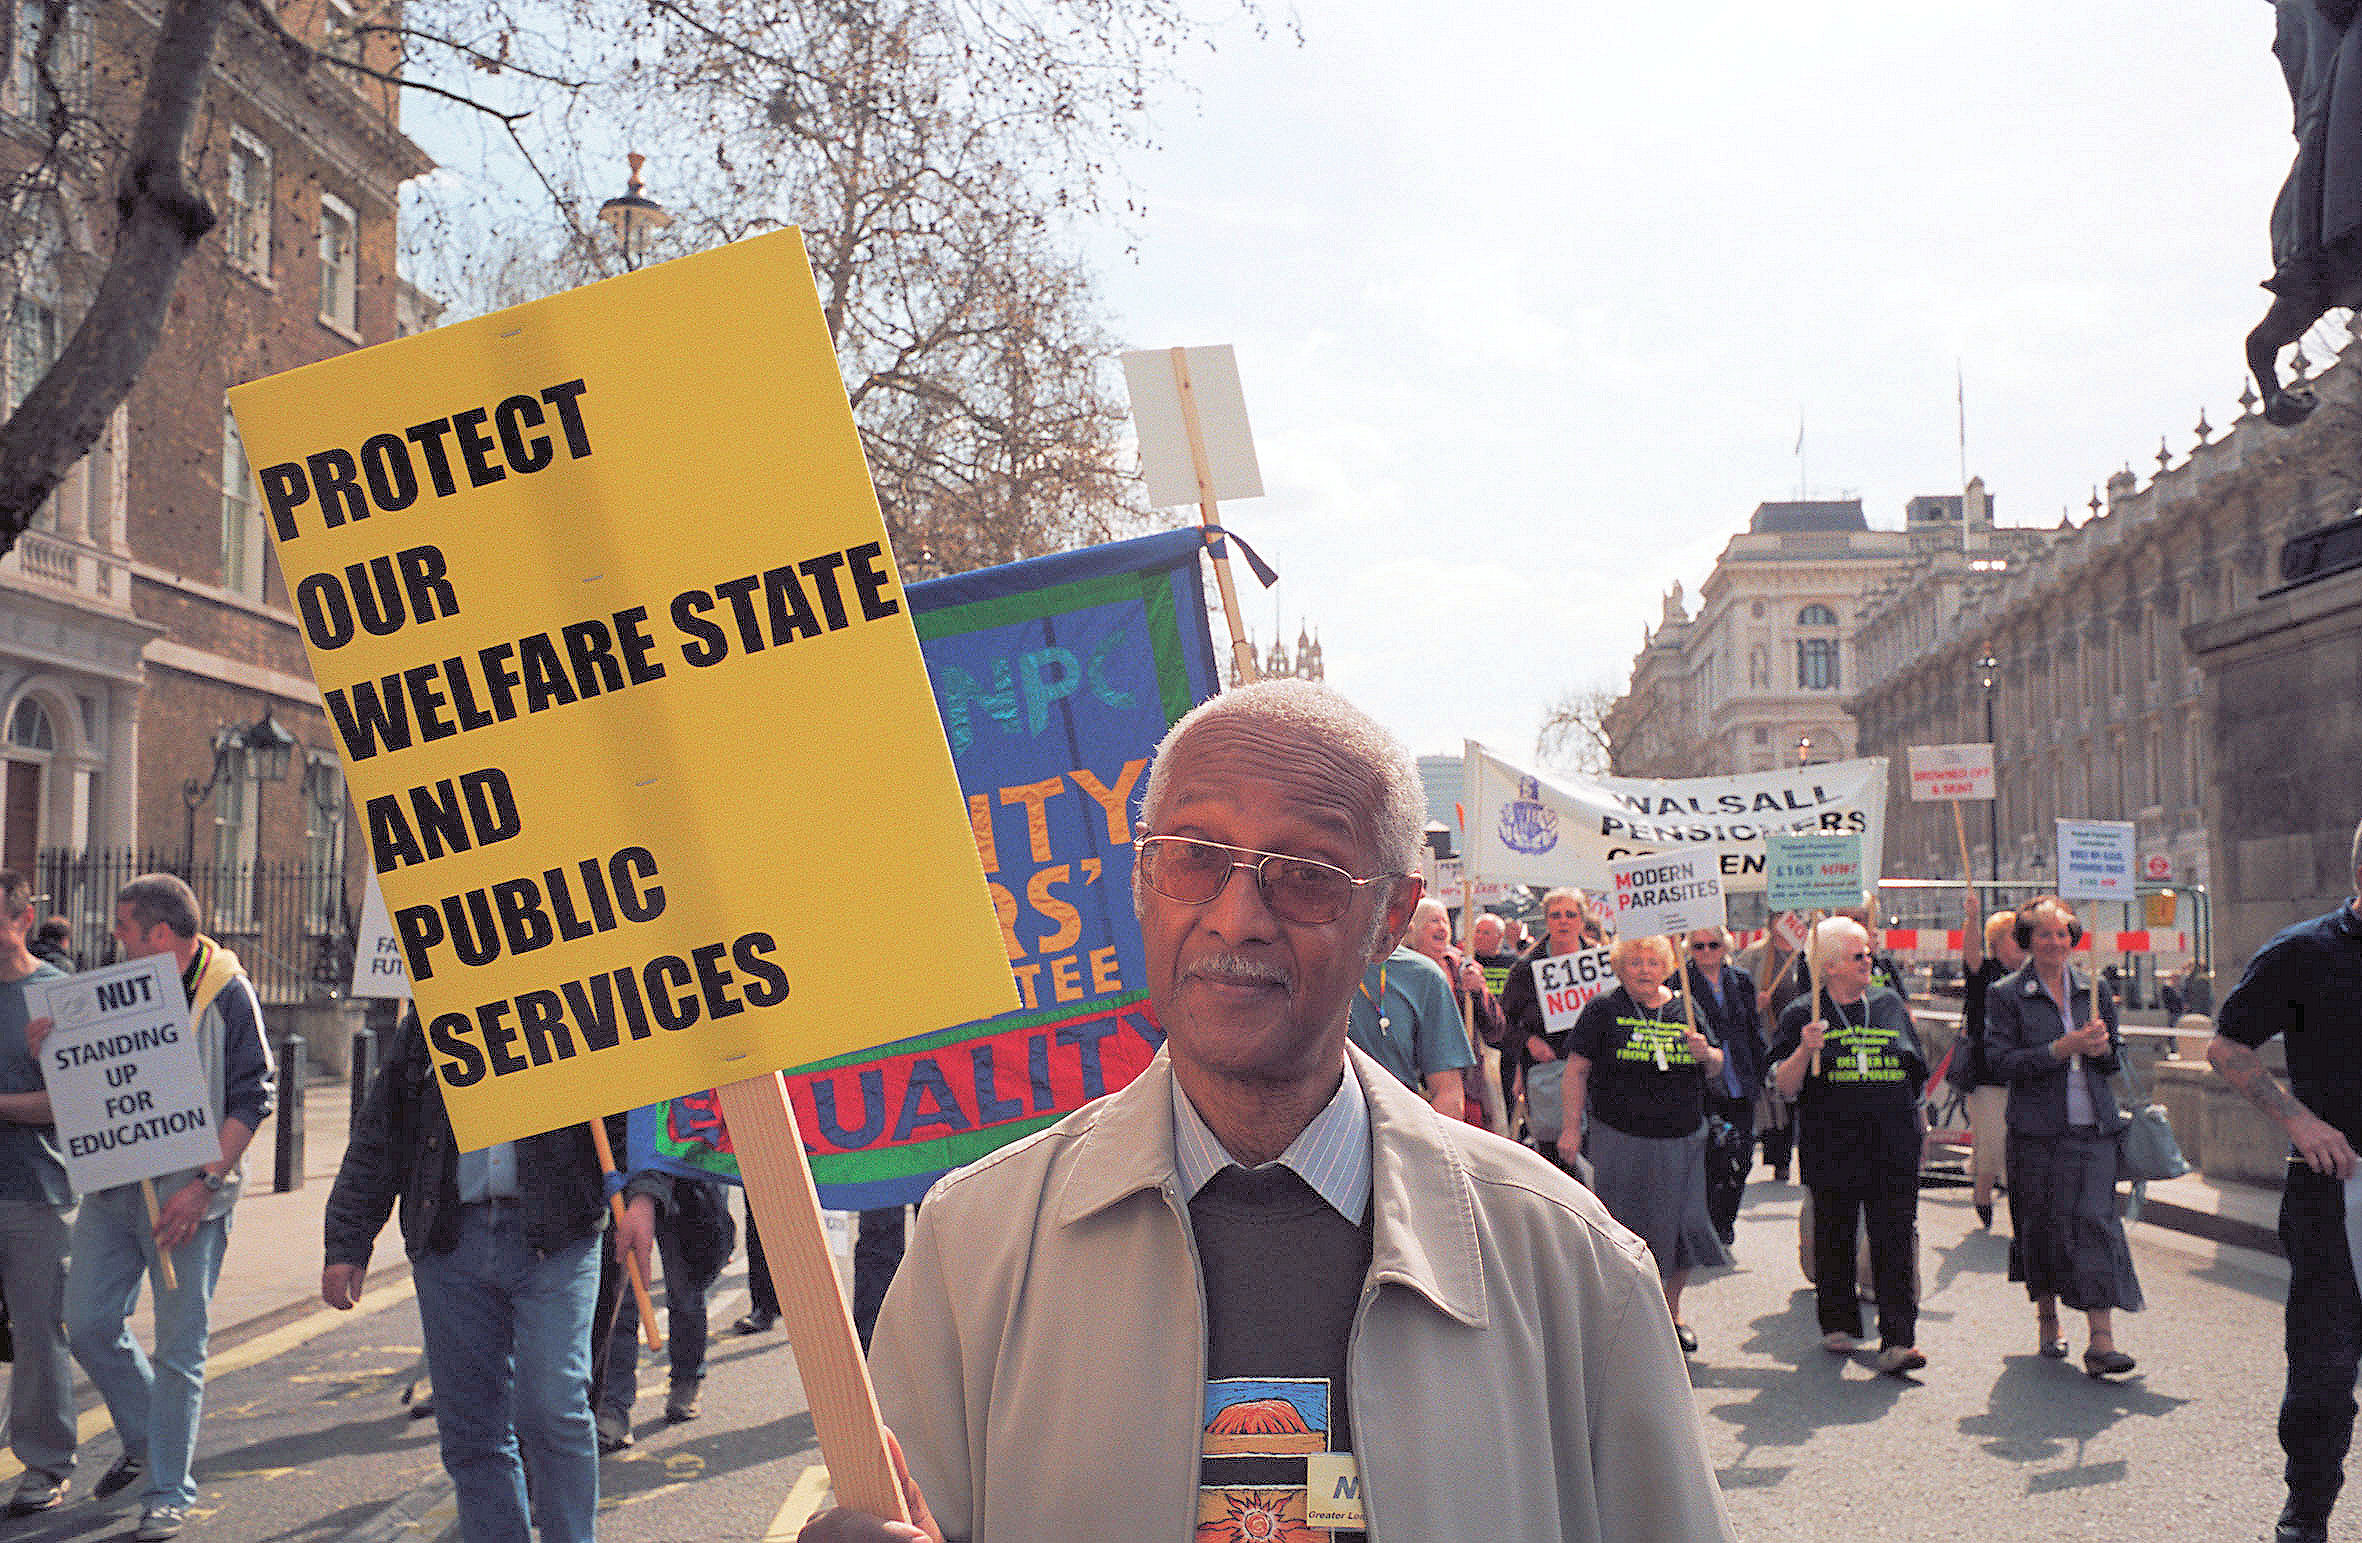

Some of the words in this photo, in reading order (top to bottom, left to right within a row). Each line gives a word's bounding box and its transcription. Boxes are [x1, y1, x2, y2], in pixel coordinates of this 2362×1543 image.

[259, 379, 592, 542] PROTECT
[297, 545, 460, 650] OUR
[324, 606, 666, 762] WELFARE
[670, 542, 899, 668] STATE
[940, 630, 1137, 757] NPC
[366, 768, 521, 874] AND
[969, 757, 1152, 874] ITY
[1612, 786, 1842, 816] WALSALL
[1601, 811, 1866, 842] PENSIOERS
[1615, 863, 1695, 891] MODERN
[1618, 879, 1720, 911] PARASITES
[394, 847, 666, 982] PUBLIC
[987, 857, 1103, 961] RS'
[372, 957, 403, 976] FUT
[377, 936, 400, 953] FA
[96, 975, 152, 1012] NUT
[1012, 945, 1123, 1009] TEE
[1543, 951, 1614, 990] £165
[429, 932, 789, 1087] SERVICES
[55, 1023, 179, 1070] STANDING
[105, 1063, 138, 1087] UP
[671, 1012, 1168, 1150] EUALITY
[105, 1090, 155, 1119] FOR
[69, 1107, 206, 1158] EDUCATION
[1308, 1511, 1346, 1520] Greater
[1348, 1511, 1368, 1520] Lon
